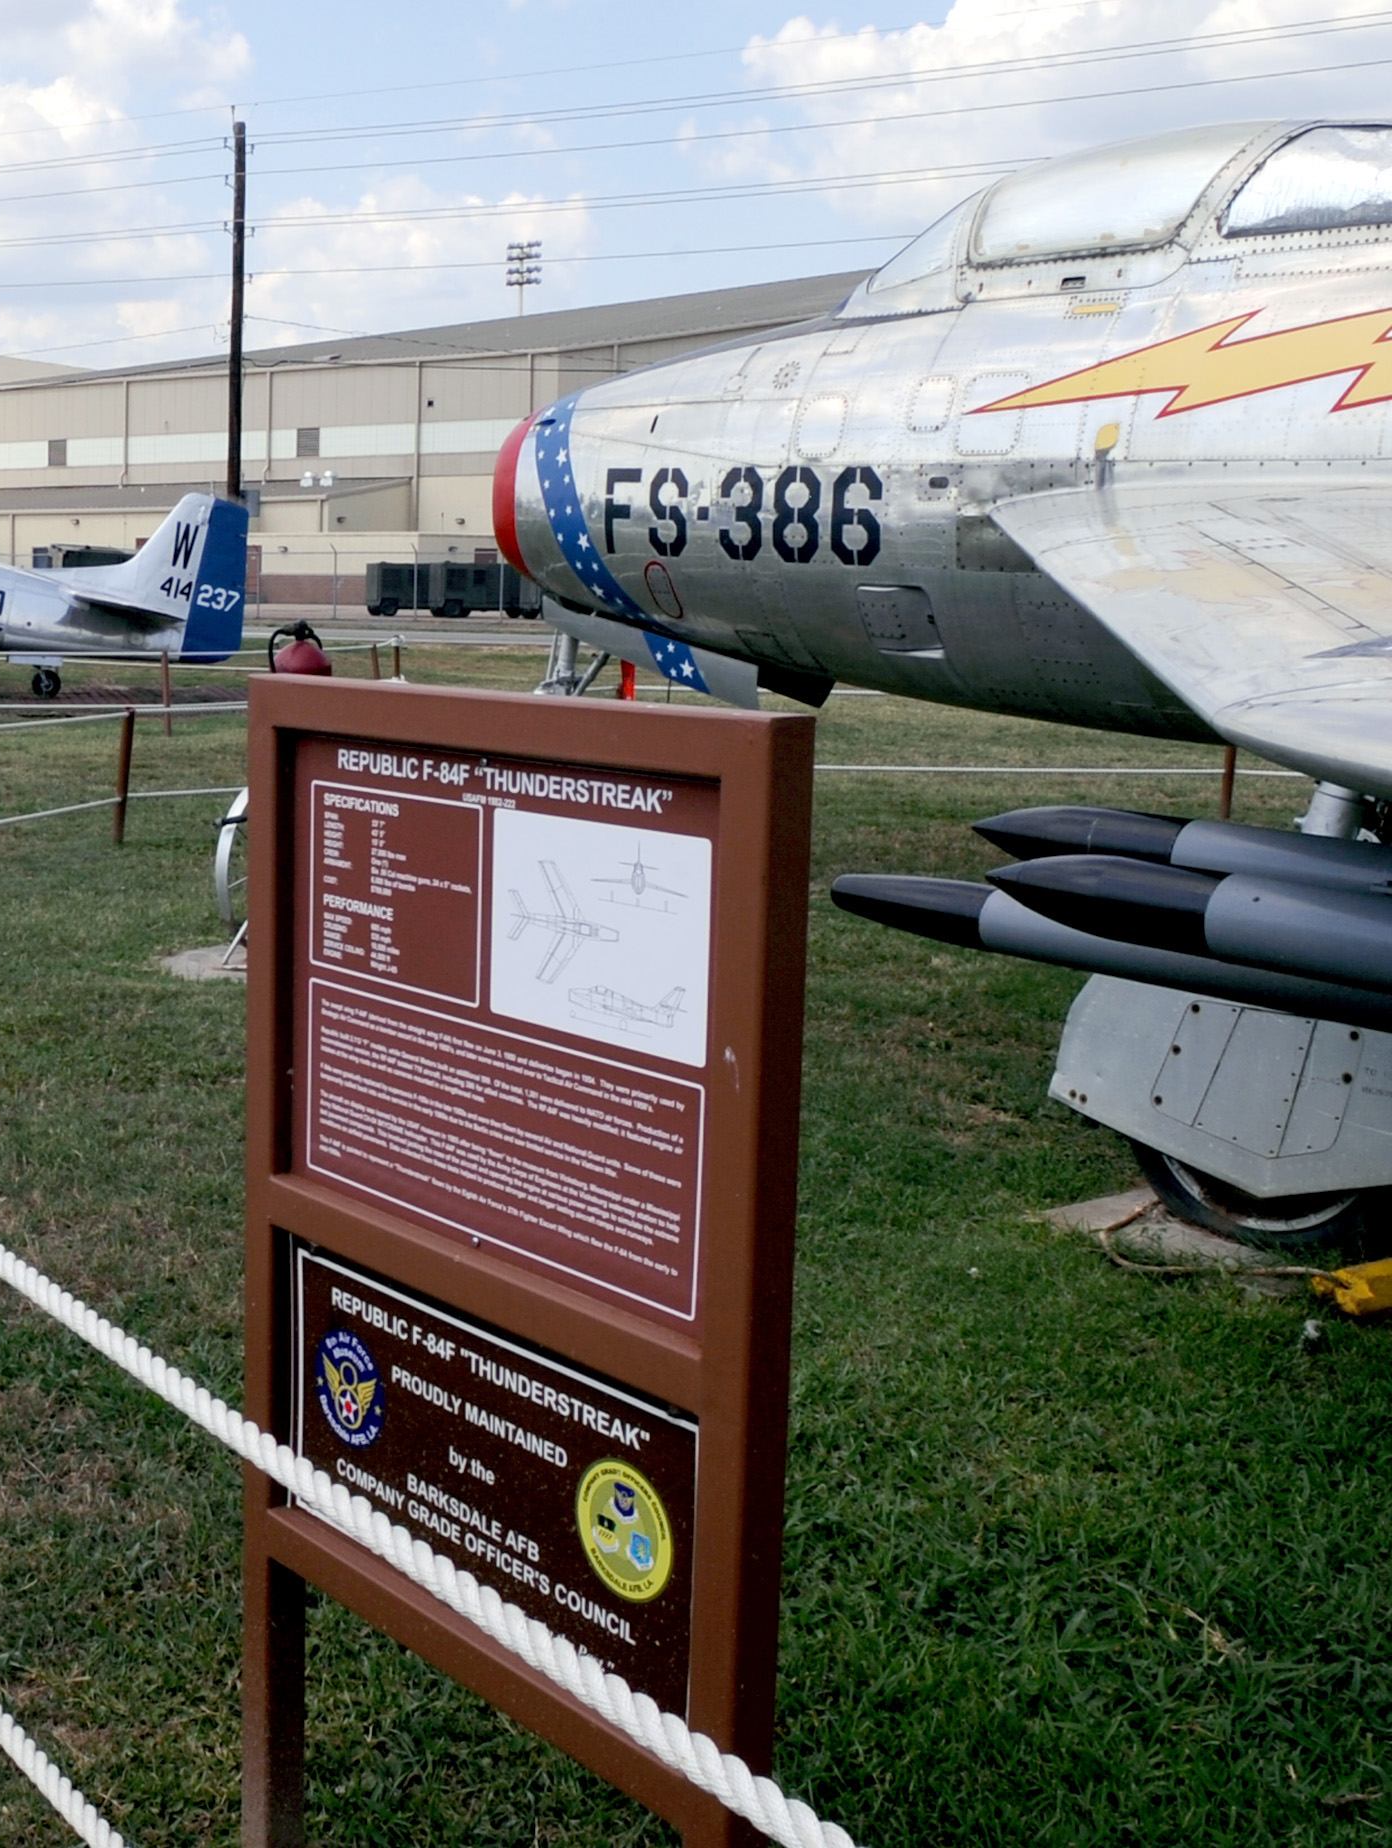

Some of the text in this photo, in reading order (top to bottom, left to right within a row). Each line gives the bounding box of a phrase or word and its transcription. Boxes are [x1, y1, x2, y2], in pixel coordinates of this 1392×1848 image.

[604, 465, 884, 567] FS-386
[172, 520, 200, 570] W
[160, 576, 241, 612] 414 237
[337, 748, 419, 779] REPUBLIC
[422, 759, 470, 786] F-84F
[323, 792, 399, 817] SPECIFICATIONS
[323, 893, 394, 921] PERFORMANCE
[331, 1286, 650, 1450] REPUBLIC F-84F "THUNDERSTREAK"
[391, 1364, 568, 1468] PROUDLY MAINTAINED
[448, 1446, 495, 1485] by the
[407, 1472, 540, 1562] BARKSDALE AFB
[337, 1457, 637, 1646] COMPANY GRADE OFFICER'S COUNCIL
